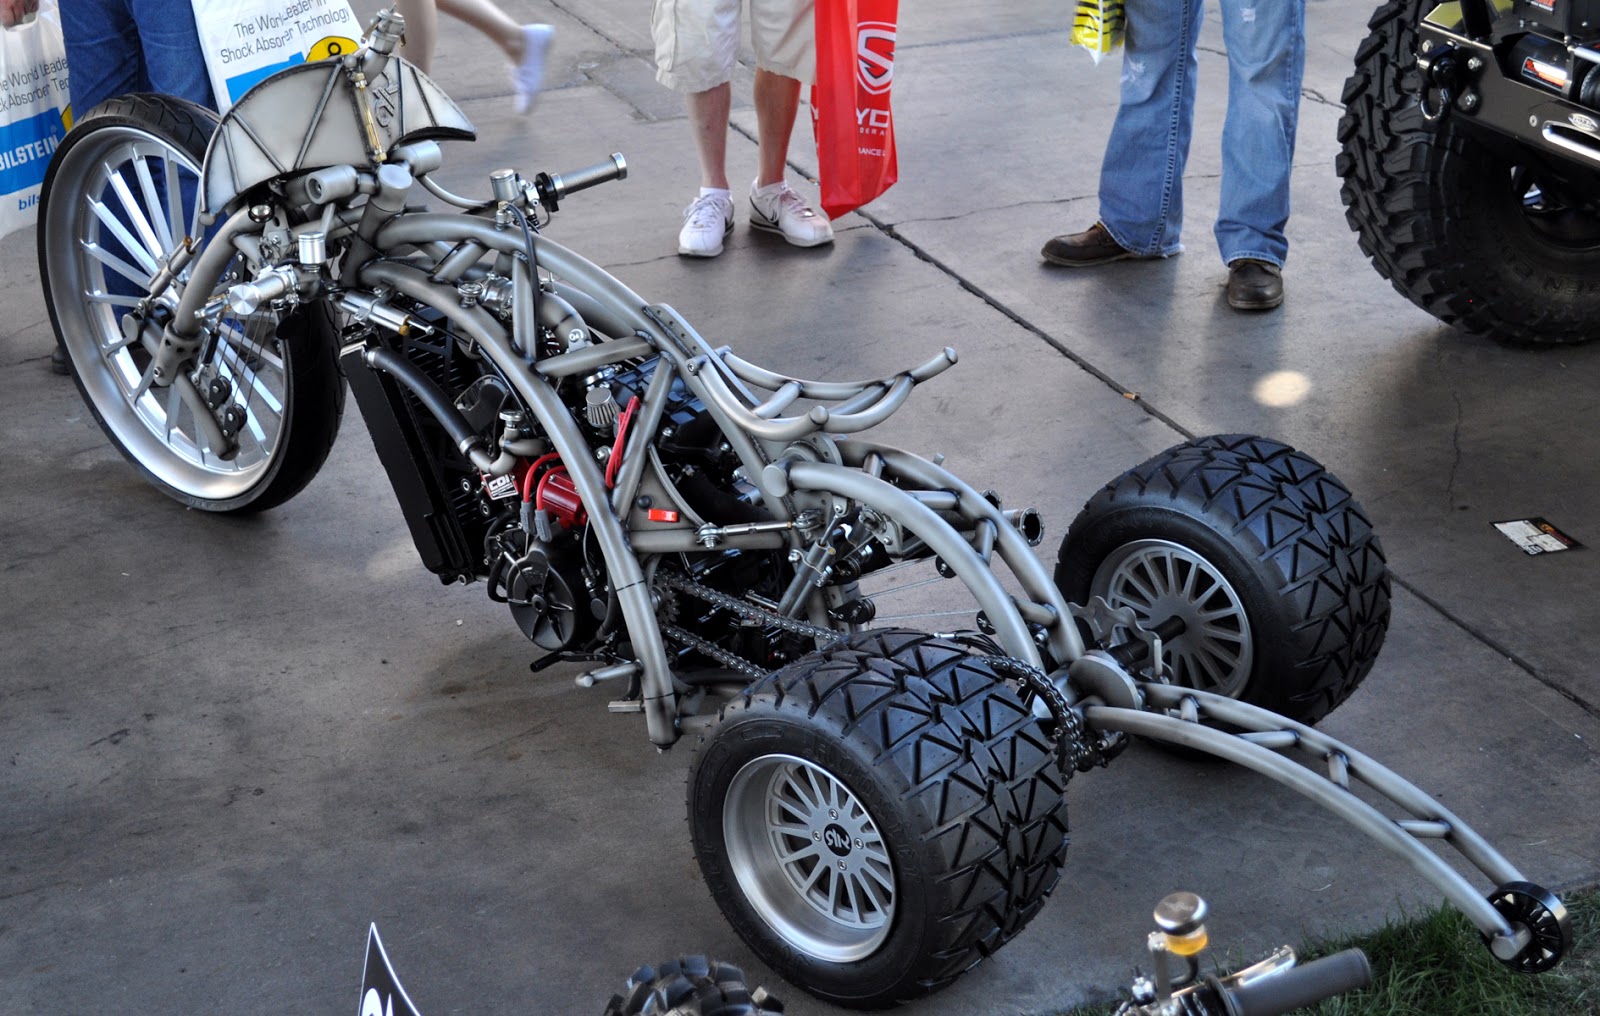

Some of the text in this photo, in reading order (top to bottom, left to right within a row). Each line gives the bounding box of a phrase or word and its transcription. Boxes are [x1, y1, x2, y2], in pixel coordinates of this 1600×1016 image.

[220, 42, 254, 64] Shock
[294, 7, 350, 35] Technology
[233, 22, 255, 38] The
[488, 474, 510, 490] CDI
